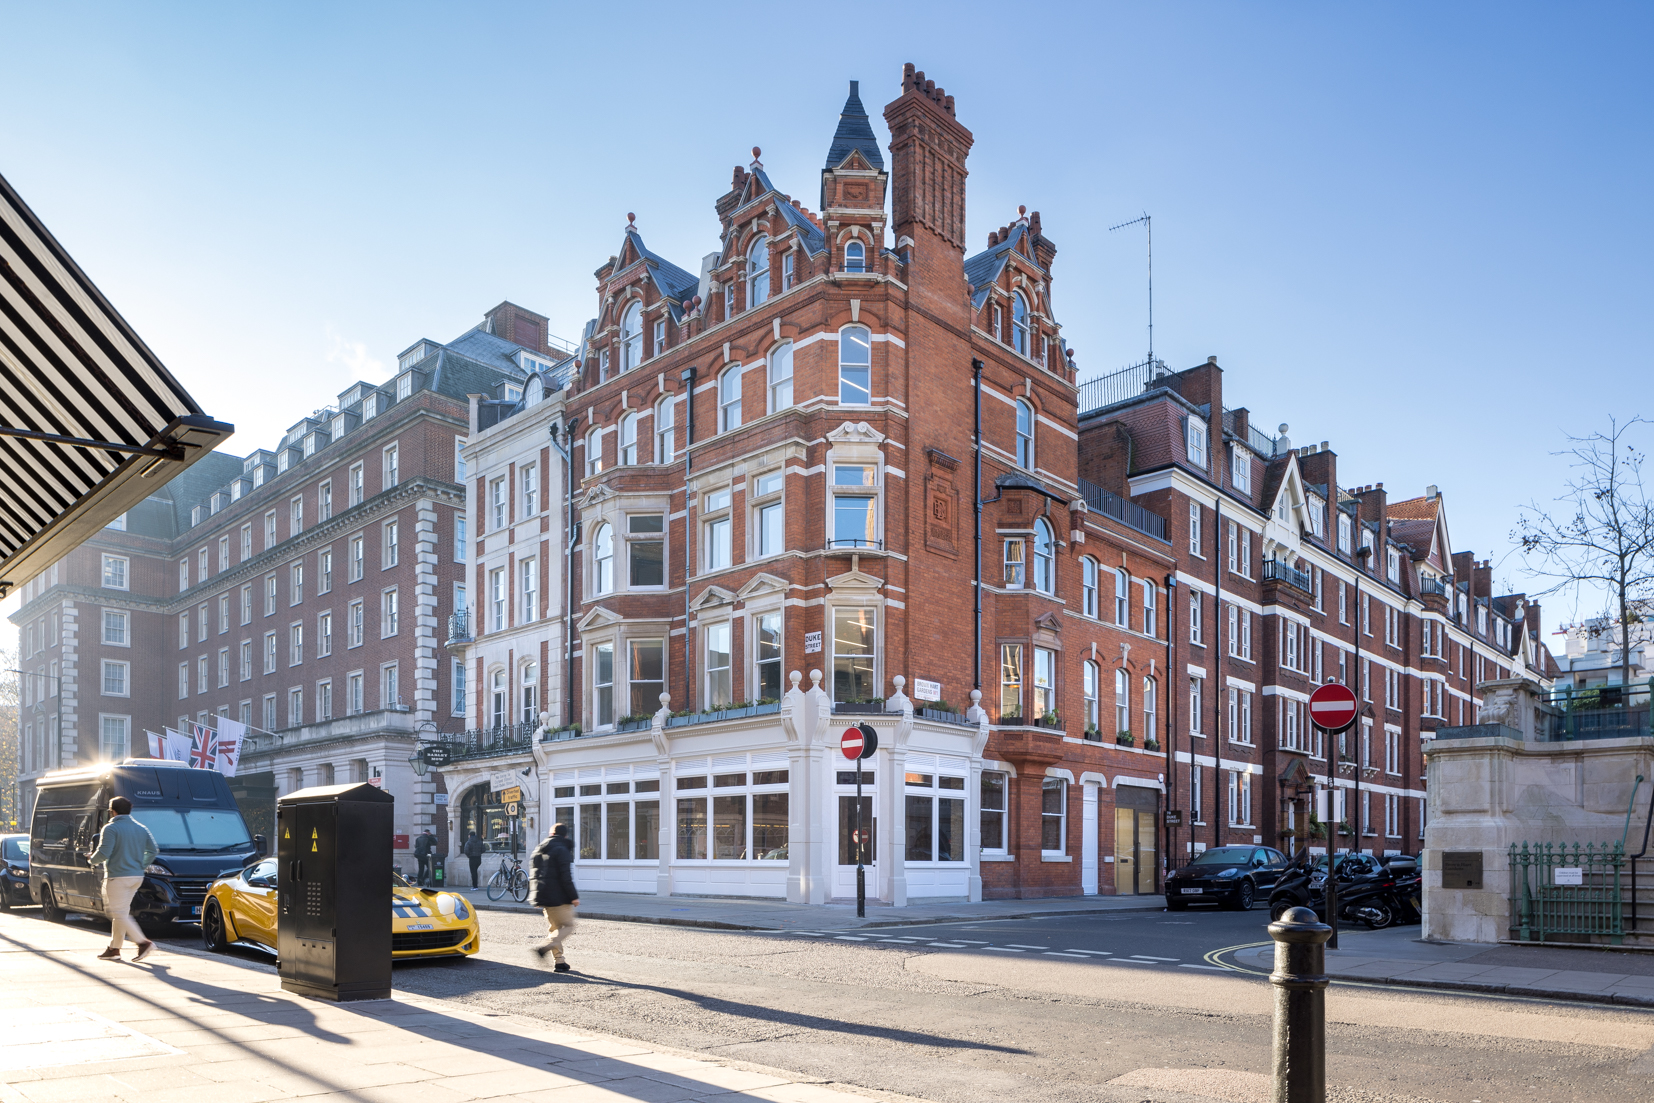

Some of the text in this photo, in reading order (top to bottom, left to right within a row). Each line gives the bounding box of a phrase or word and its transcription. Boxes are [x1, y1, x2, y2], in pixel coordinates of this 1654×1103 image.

[805, 634, 821, 642] DUKE
[917, 681, 929, 689] BROWN
[917, 687, 932, 695] GARDENS
